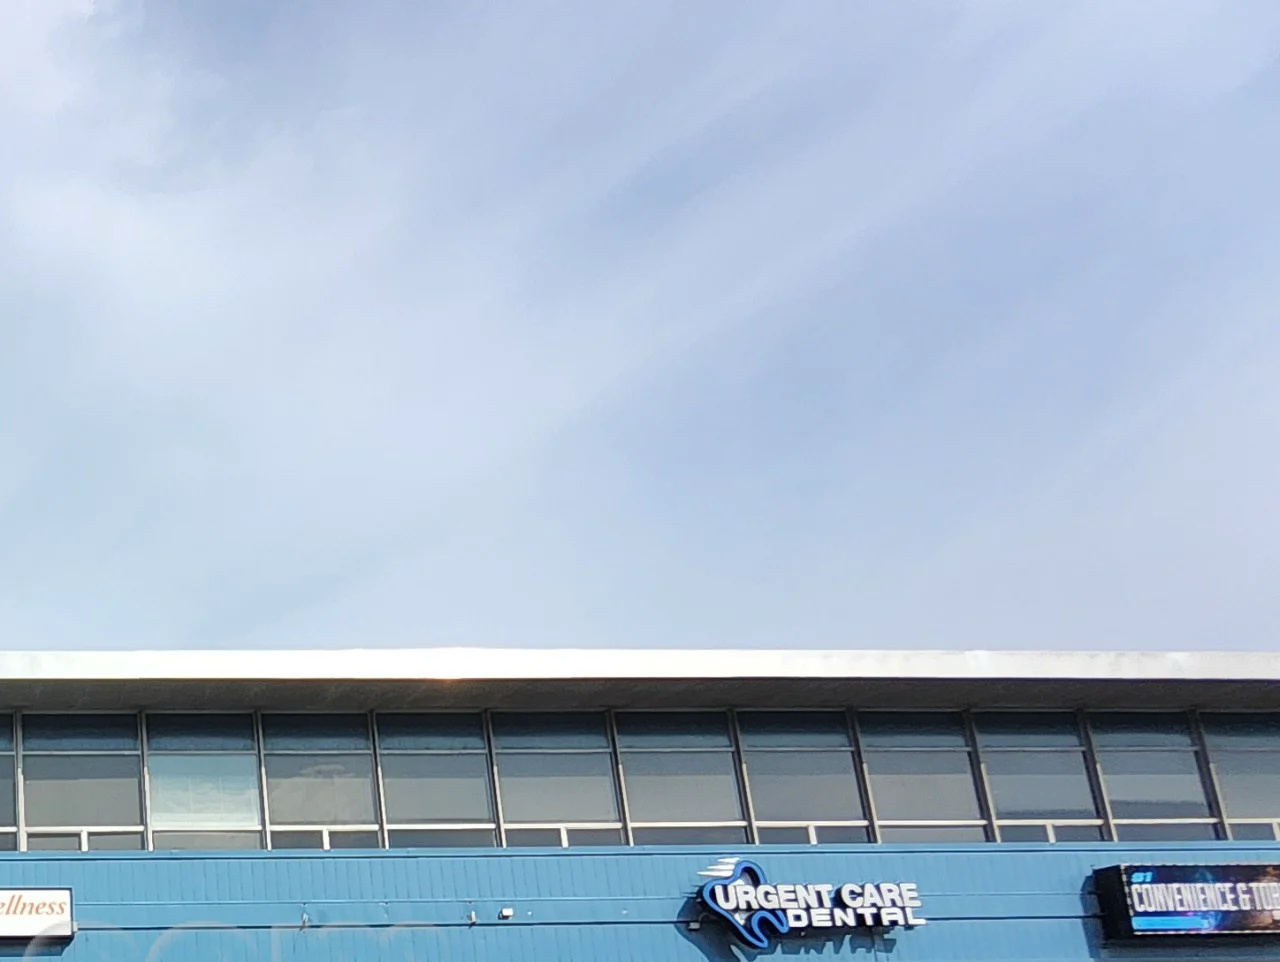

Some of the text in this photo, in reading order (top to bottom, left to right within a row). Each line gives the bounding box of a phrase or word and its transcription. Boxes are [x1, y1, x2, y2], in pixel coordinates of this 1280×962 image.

[714, 883, 922, 910] URGENT CARE
[1131, 882, 1239, 912] CONVENIENCE
[1237, 882, 1252, 911] &
[786, 907, 927, 927] DENTAL
